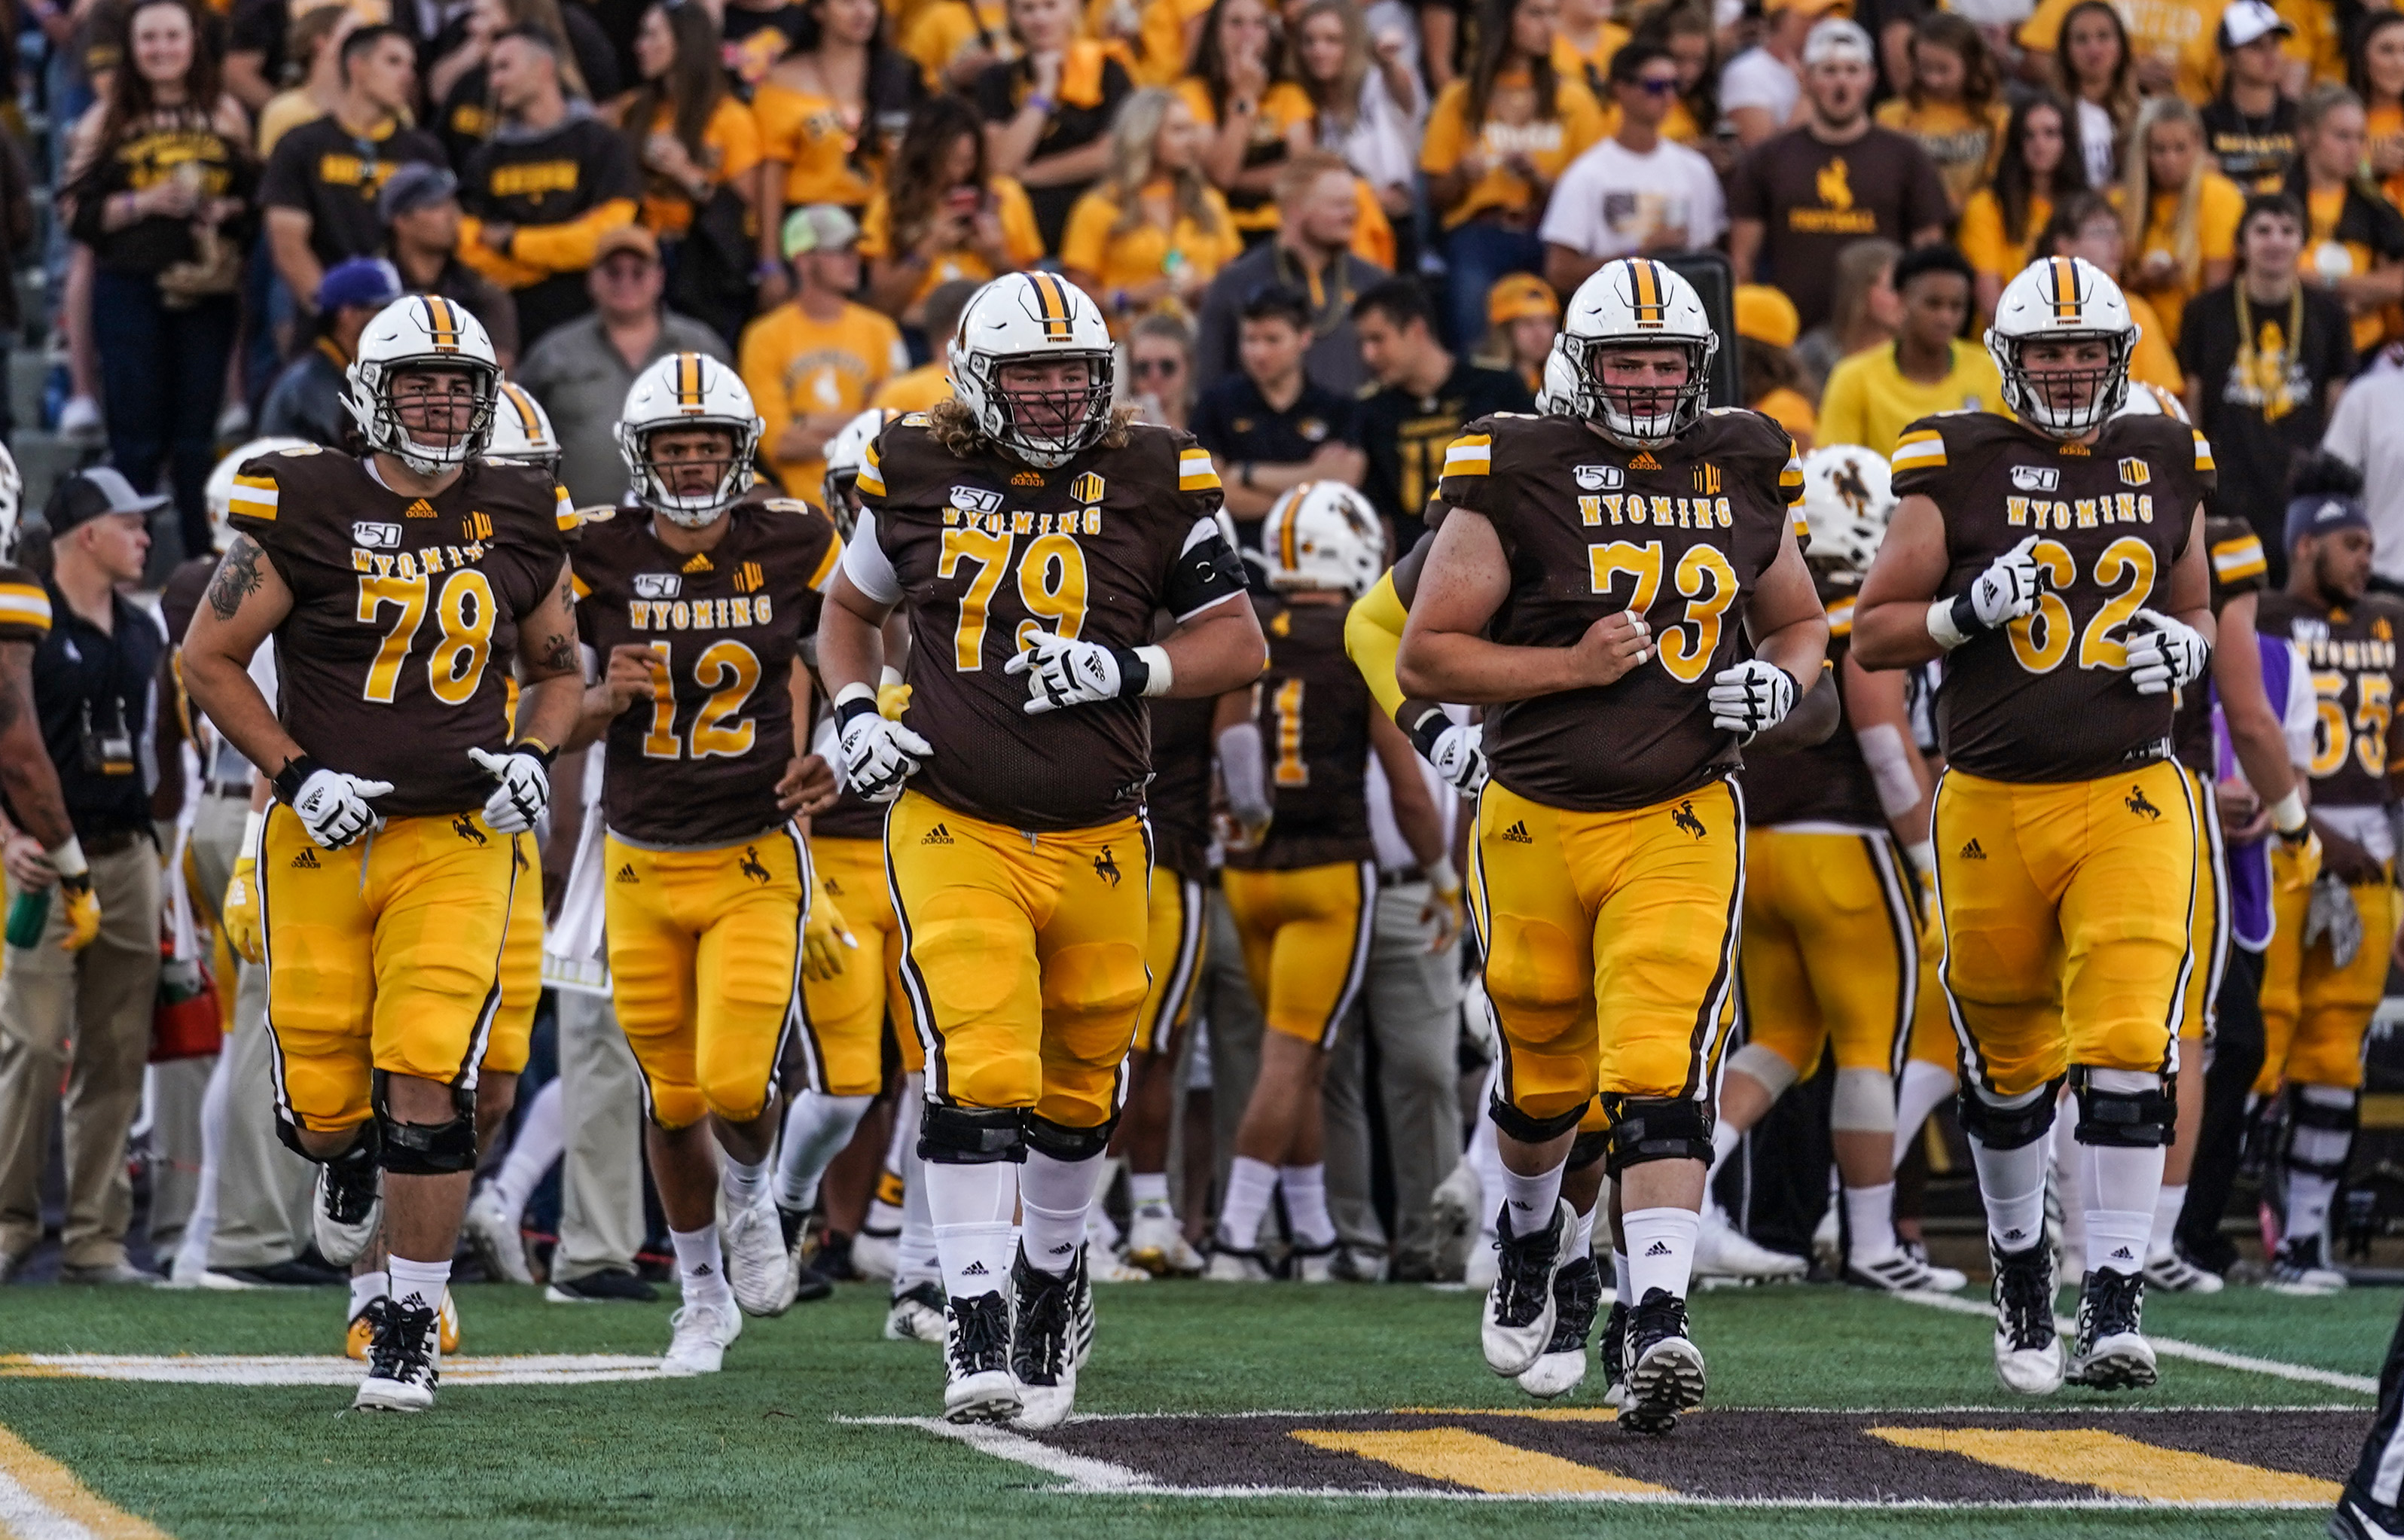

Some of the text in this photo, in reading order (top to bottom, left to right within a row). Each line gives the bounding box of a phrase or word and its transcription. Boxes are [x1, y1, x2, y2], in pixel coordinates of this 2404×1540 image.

[1011, 476, 1045, 487] adidas
[1573, 465, 1625, 490] 150
[1628, 461, 1662, 471] adidas
[405, 508, 438, 518] adidas
[950, 485, 1004, 514] 150
[1577, 493, 1733, 529] WYOMING
[2006, 492, 2154, 530] WYOMING
[352, 520, 402, 548] 150
[942, 506, 1102, 535] WYOMING
[630, 595, 773, 631] WYOMING
[937, 527, 1089, 672] 79
[1588, 540, 1740, 684] 73
[2006, 535, 2157, 674] 62
[357, 568, 499, 706] 78
[643, 639, 762, 761] 12
[2309, 668, 2393, 779] 55
[920, 836, 955, 845] adidas
